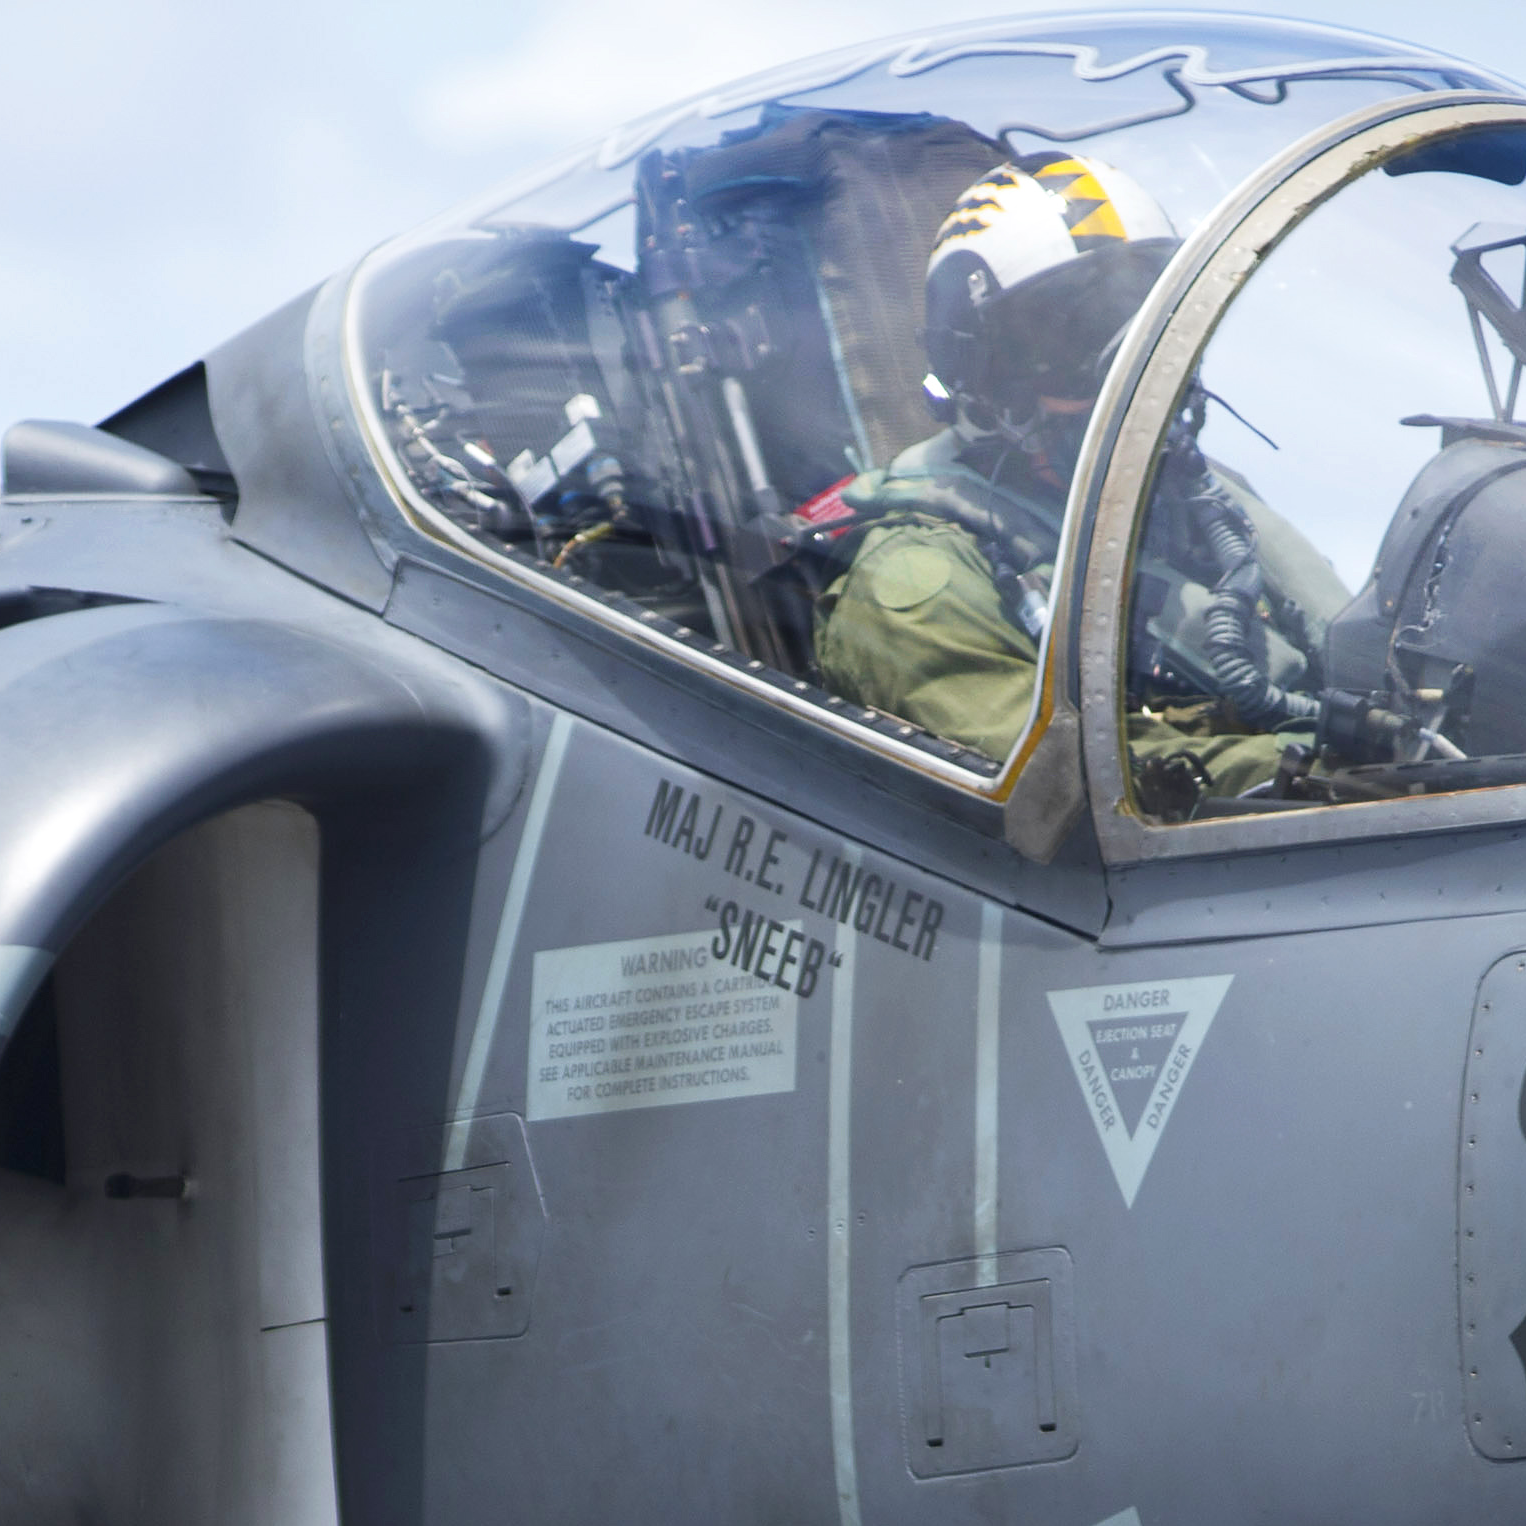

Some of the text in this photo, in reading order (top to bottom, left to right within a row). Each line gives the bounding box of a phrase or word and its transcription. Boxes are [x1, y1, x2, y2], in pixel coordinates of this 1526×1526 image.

[644, 778, 944, 962] MAJ R.E. LINGLER
[620, 946, 710, 977] WARNING
[545, 997, 569, 1015] THIS
[573, 989, 632, 1012] AIRCRAFT
[635, 982, 696, 1003] CONTAINS
[701, 981, 710, 995] A
[546, 995, 780, 1037] ACTUATED EMERGENCY ESCAPE SYSTEM
[1103, 989, 1170, 1012] DANGER
[549, 1018, 774, 1059] EQUIPPED WITH EXPLOSIVE CHARGES.
[1096, 1023, 1177, 1043] EJECTION SEAT
[539, 1039, 784, 1082] SEE APPLICABLE MAINTENANCE MANUAL
[1110, 1065, 1158, 1081] CANOPY
[567, 1066, 751, 1102] FOR COMPLETE INSTRUCTIONS.
[1078, 1049, 1115, 1132] DANGER
[1146, 1043, 1192, 1129] DANGER
